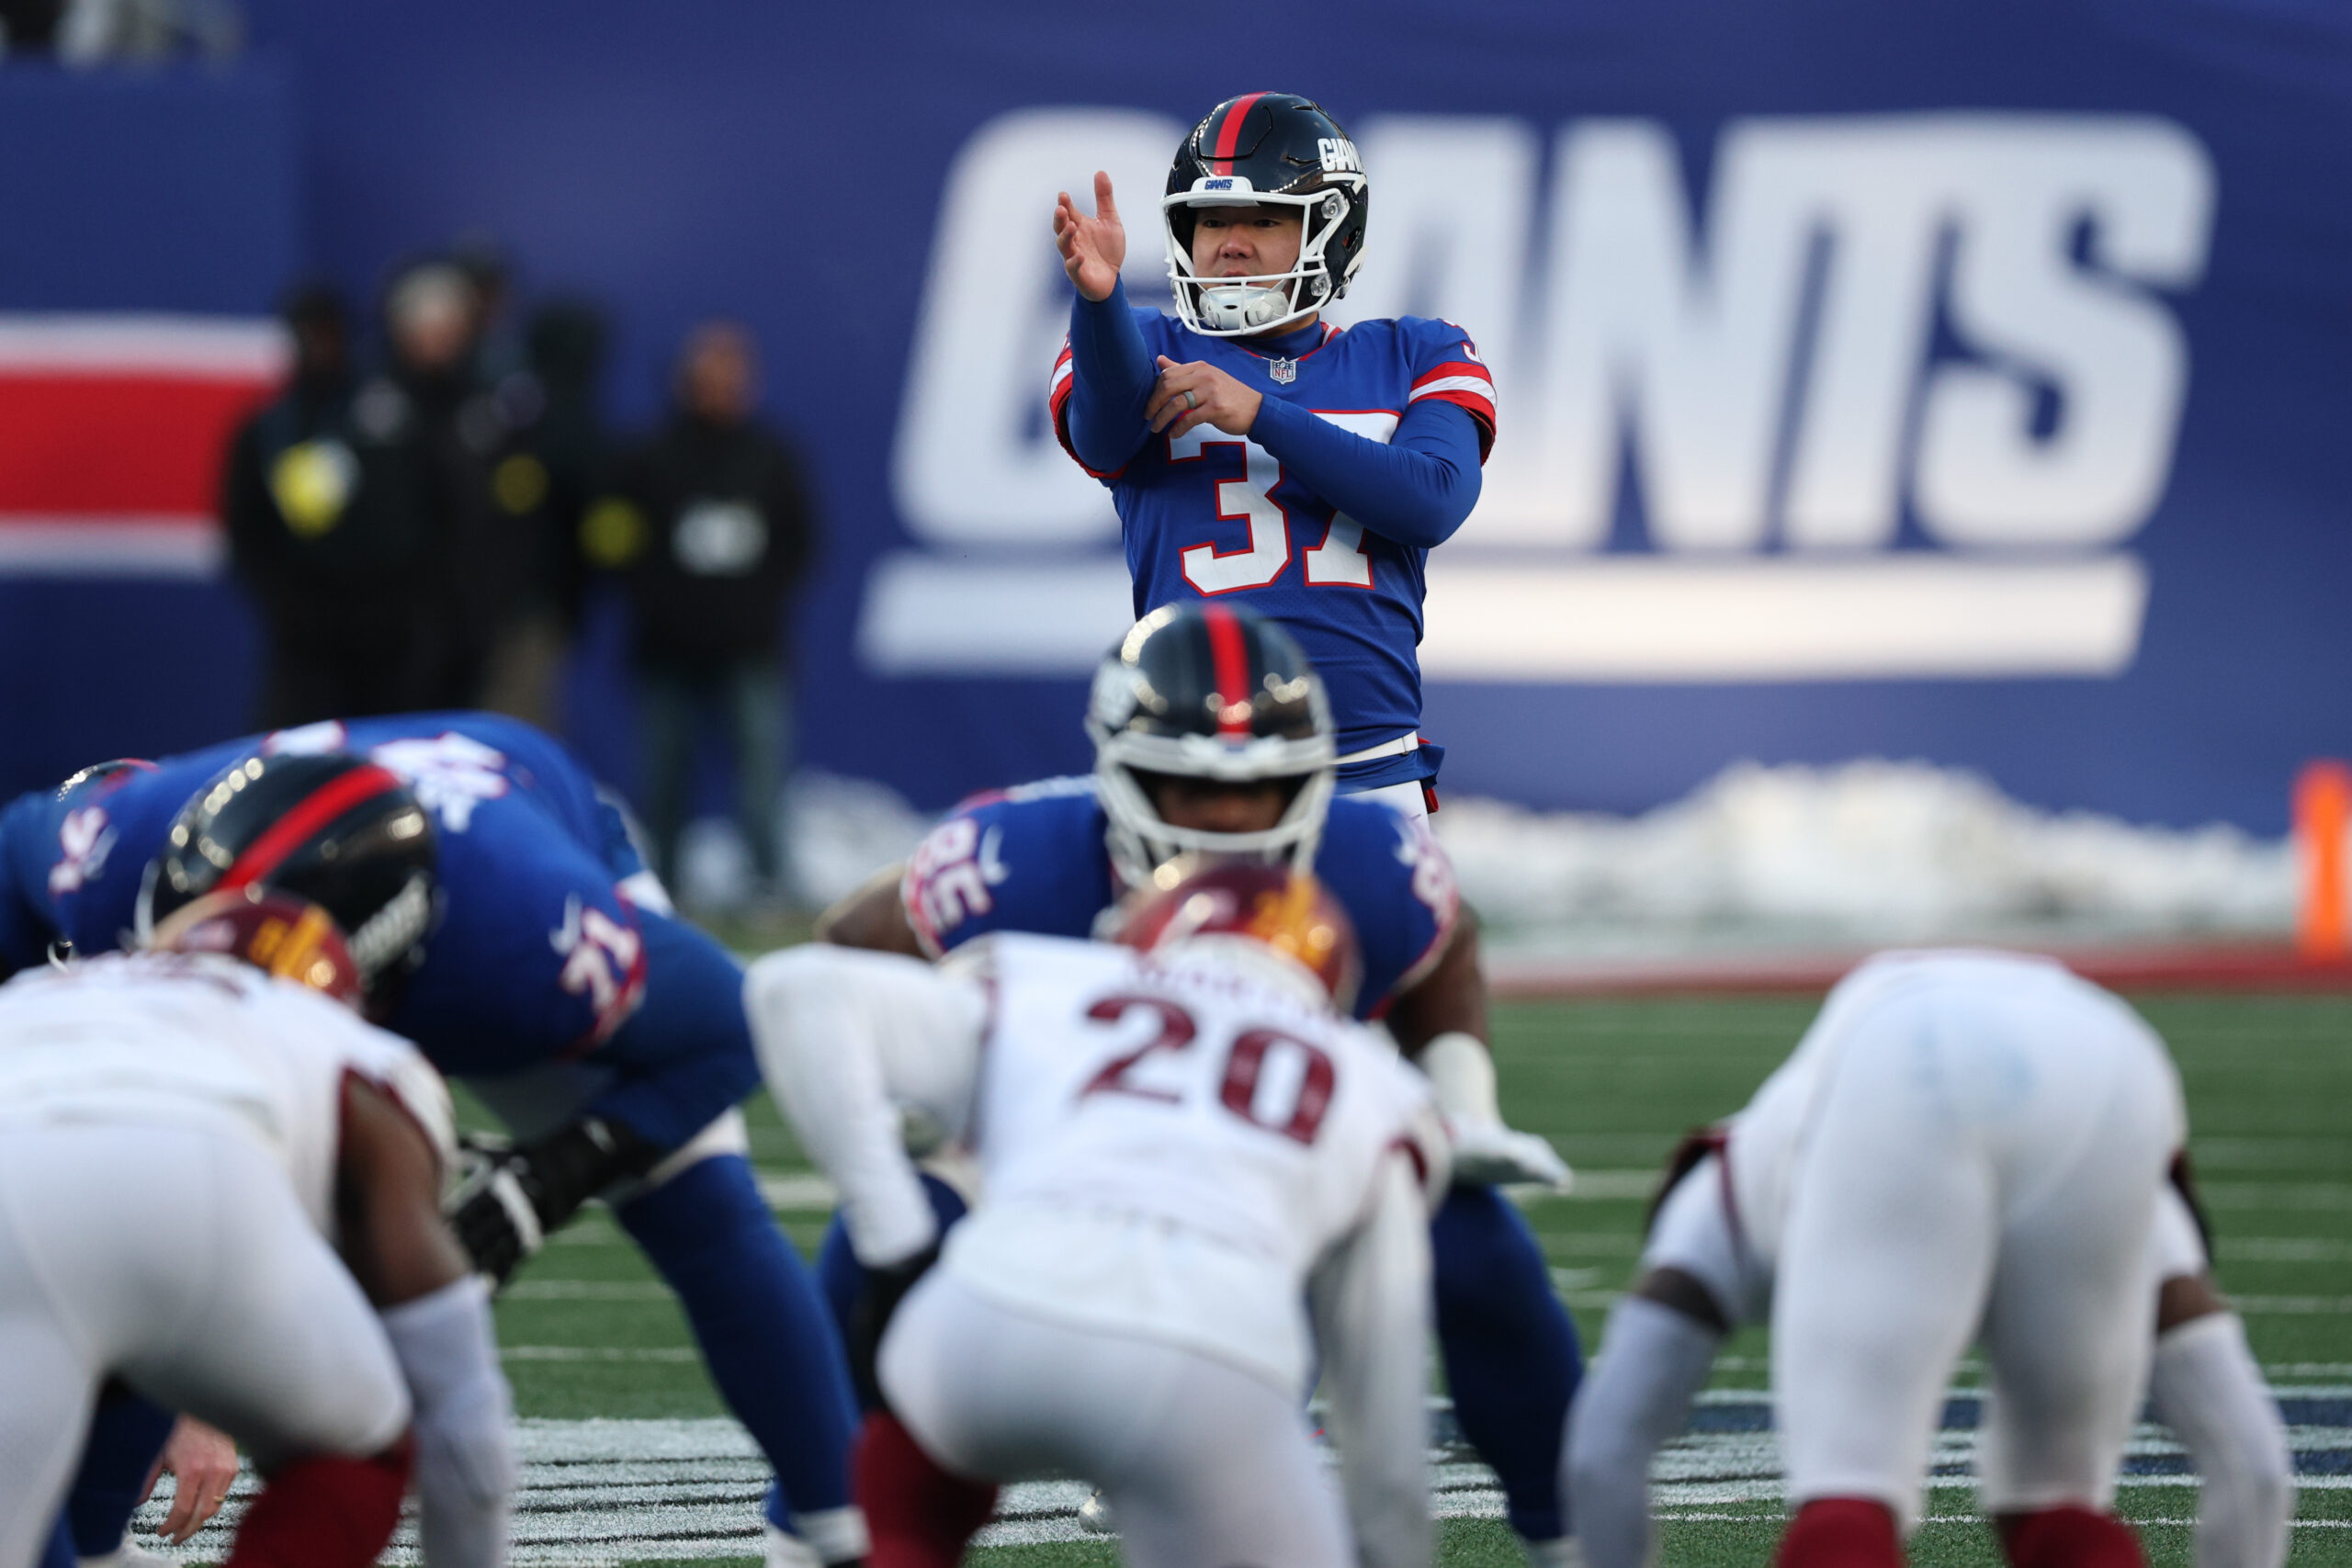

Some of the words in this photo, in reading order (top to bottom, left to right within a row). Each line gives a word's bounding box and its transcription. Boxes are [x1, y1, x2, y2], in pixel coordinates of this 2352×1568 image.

[1204, 179, 1233, 190] GIANTS
[1317, 138, 1366, 173] GIAN
[893, 108, 2214, 549] GANTS
[1274, 368, 1292, 378] NFL
[1167, 409, 1402, 597] 37
[1073, 995, 1337, 1145] 20
